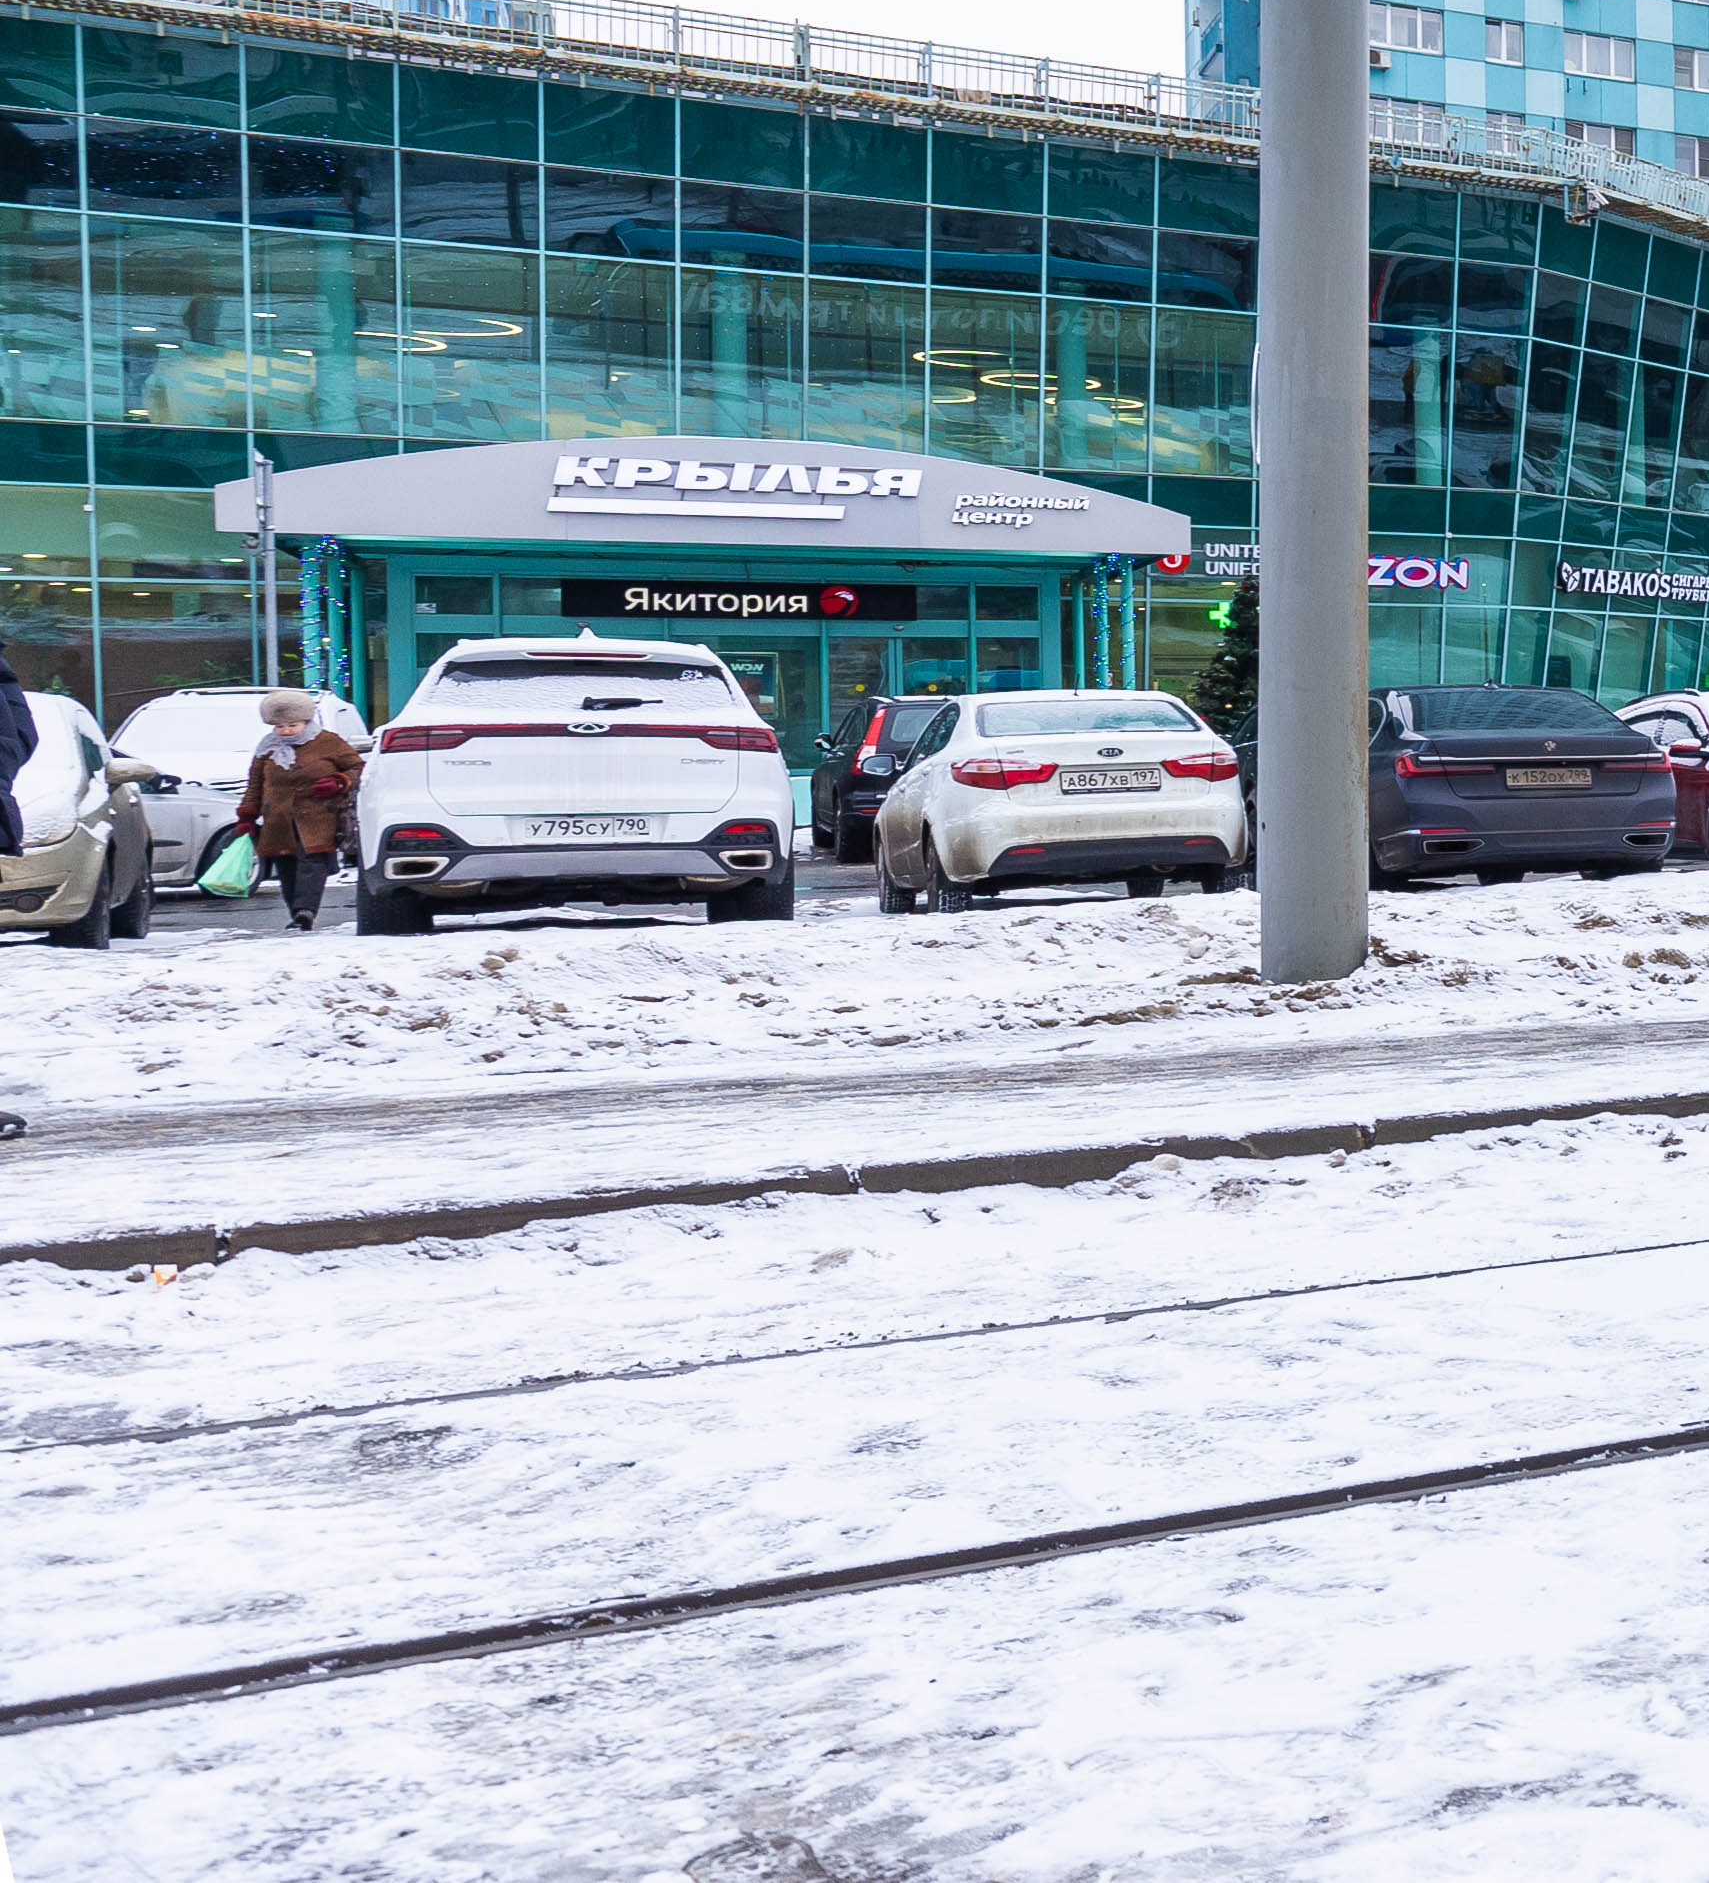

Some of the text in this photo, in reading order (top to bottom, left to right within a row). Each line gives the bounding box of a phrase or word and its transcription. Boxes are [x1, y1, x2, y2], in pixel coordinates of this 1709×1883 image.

[553, 455, 923, 497] КРЫЛЬЯ
[955, 492, 1091, 511] районный
[952, 511, 1034, 529] центр
[1205, 543, 1260, 559] UNITE
[1205, 561, 1260, 576] UNIF
[1368, 557, 1470, 589] ZON
[624, 587, 808, 617] Якитория
[1100, 748, 1121, 757] KIA
[1067, 770, 1156, 787] А867ХВ 197
[531, 818, 647, 836] У795СУ 790
